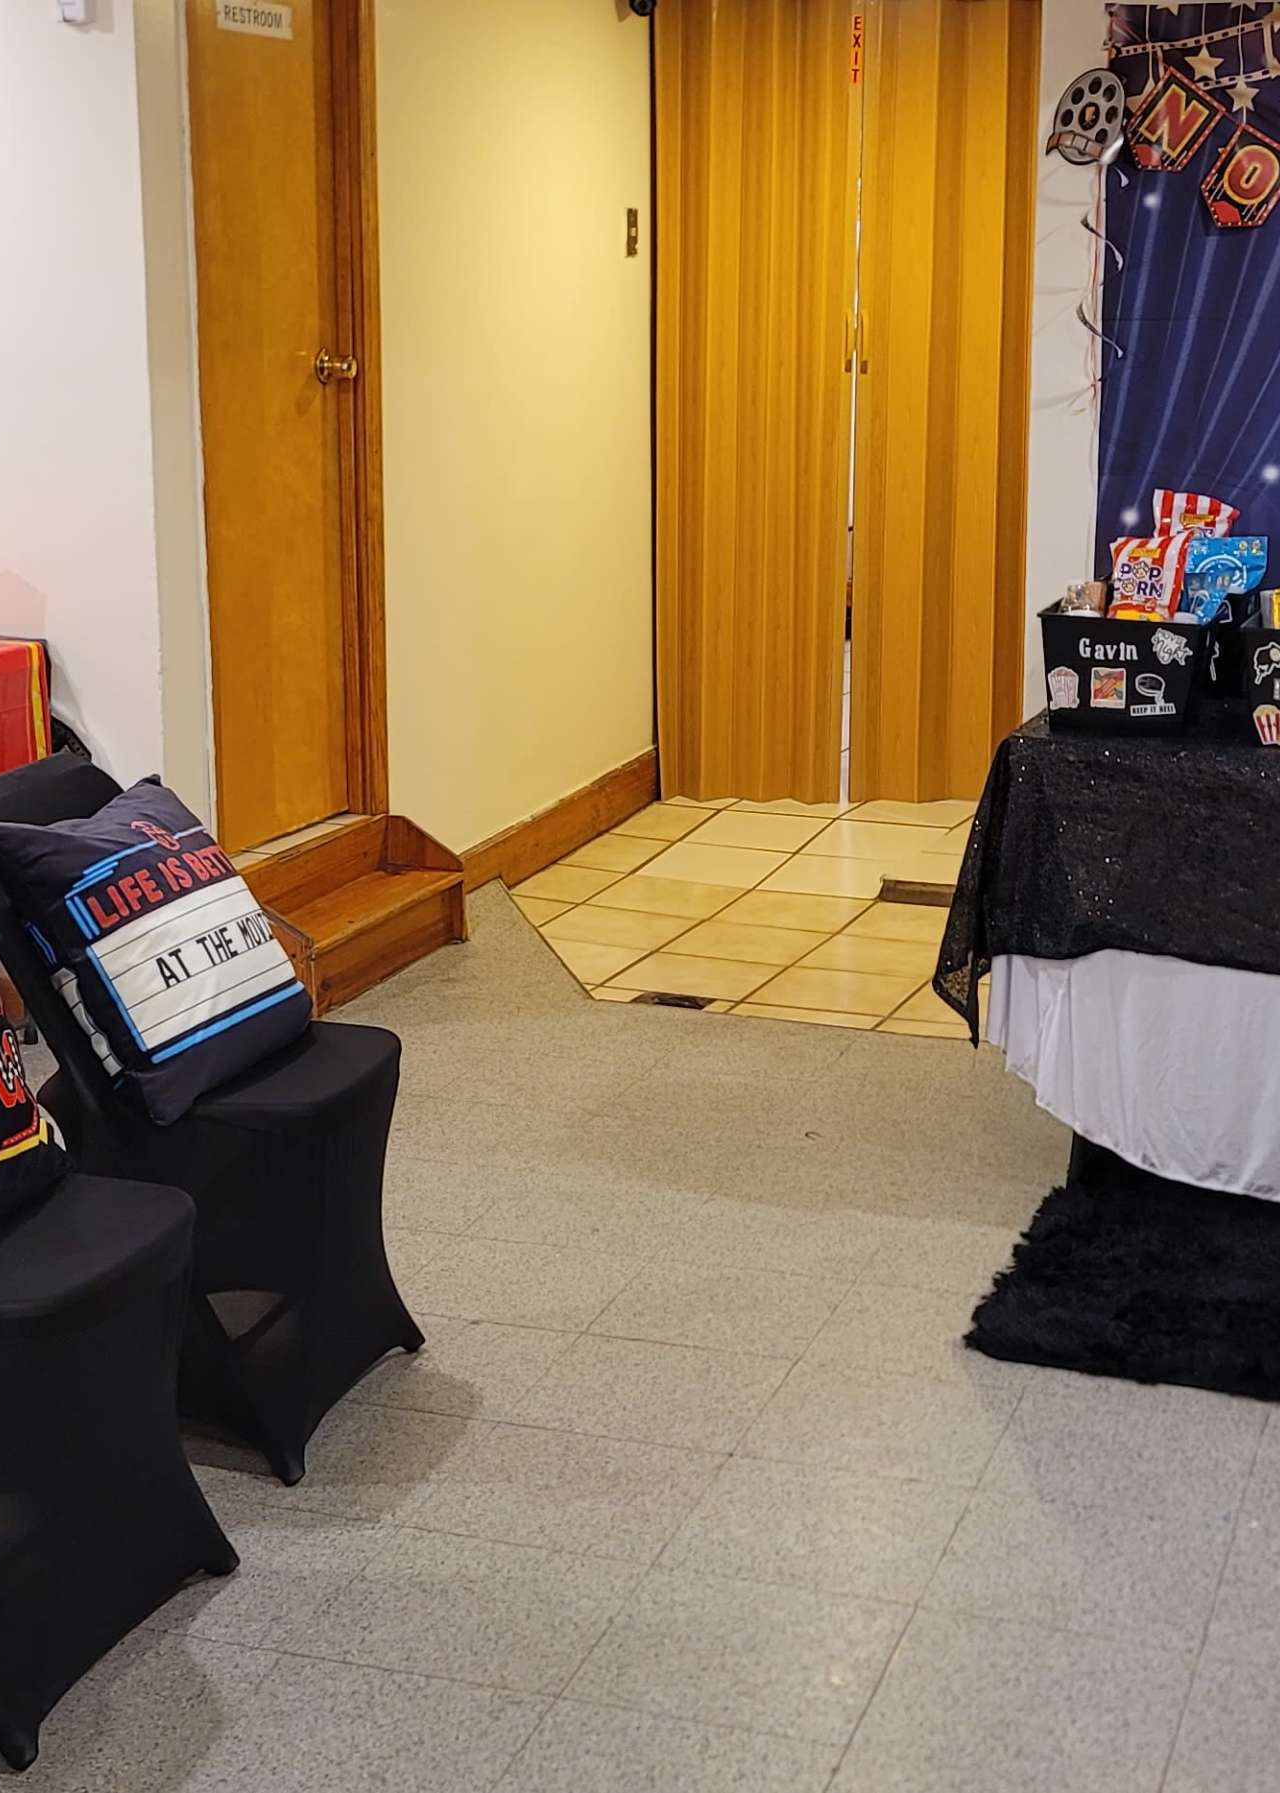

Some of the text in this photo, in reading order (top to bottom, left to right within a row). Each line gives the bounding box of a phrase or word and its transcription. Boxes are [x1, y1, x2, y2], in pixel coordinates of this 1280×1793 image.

[223, 4, 282, 29] RESTROOM
[852, 15, 862, 84] EXIT
[87, 869, 164, 929] LIFE
[158, 857, 193, 892] IS
[155, 948, 192, 989] AT
[196, 927, 239, 967] THE
